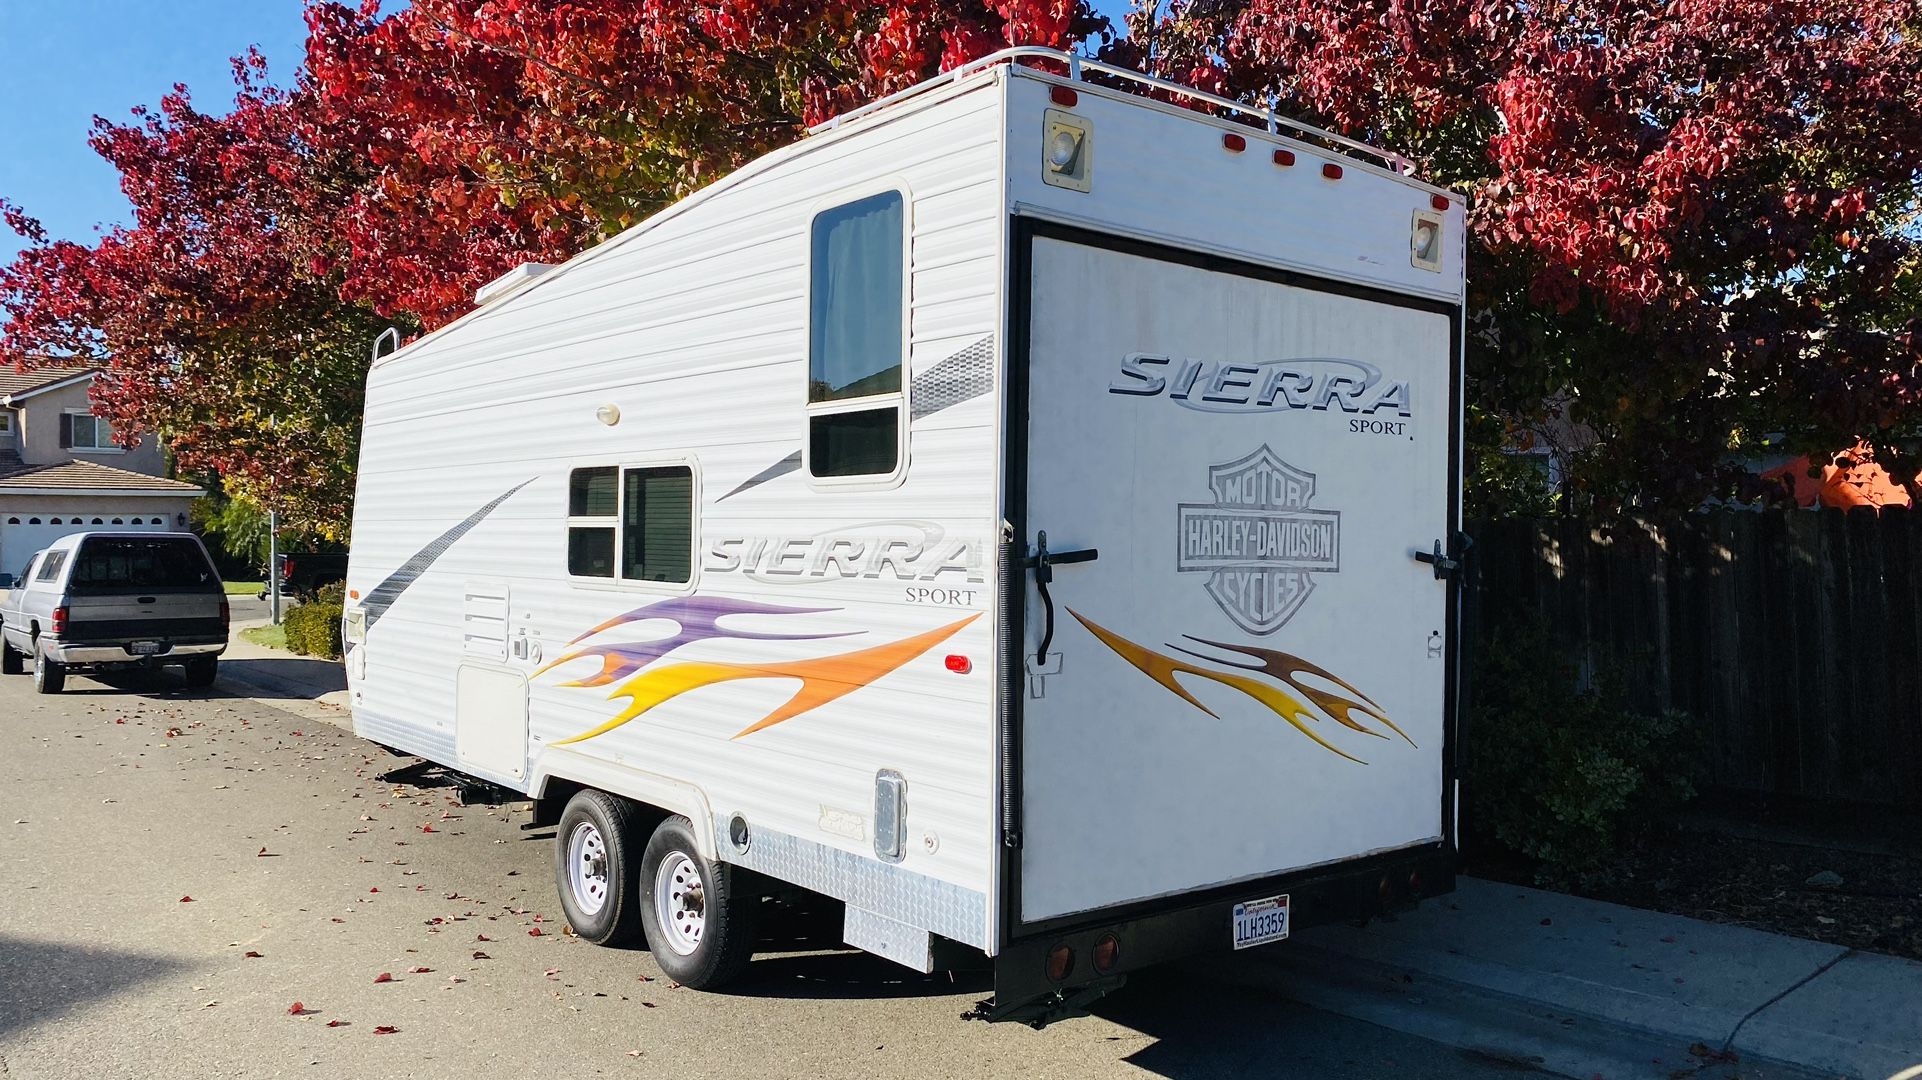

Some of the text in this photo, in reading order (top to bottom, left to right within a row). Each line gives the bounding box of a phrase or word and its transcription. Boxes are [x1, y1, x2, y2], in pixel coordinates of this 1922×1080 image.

[1109, 351, 1411, 417] SIERRA
[1350, 419, 1407, 435] SPORT
[1226, 468, 1301, 506] MOTOR
[1187, 519, 1332, 559] HARLEY-DAVIDSON
[704, 537, 984, 584] SIERRA
[905, 587, 977, 606] SPORT
[1223, 572, 1299, 622] CYCLES
[1237, 912, 1285, 942] 1LH3359
